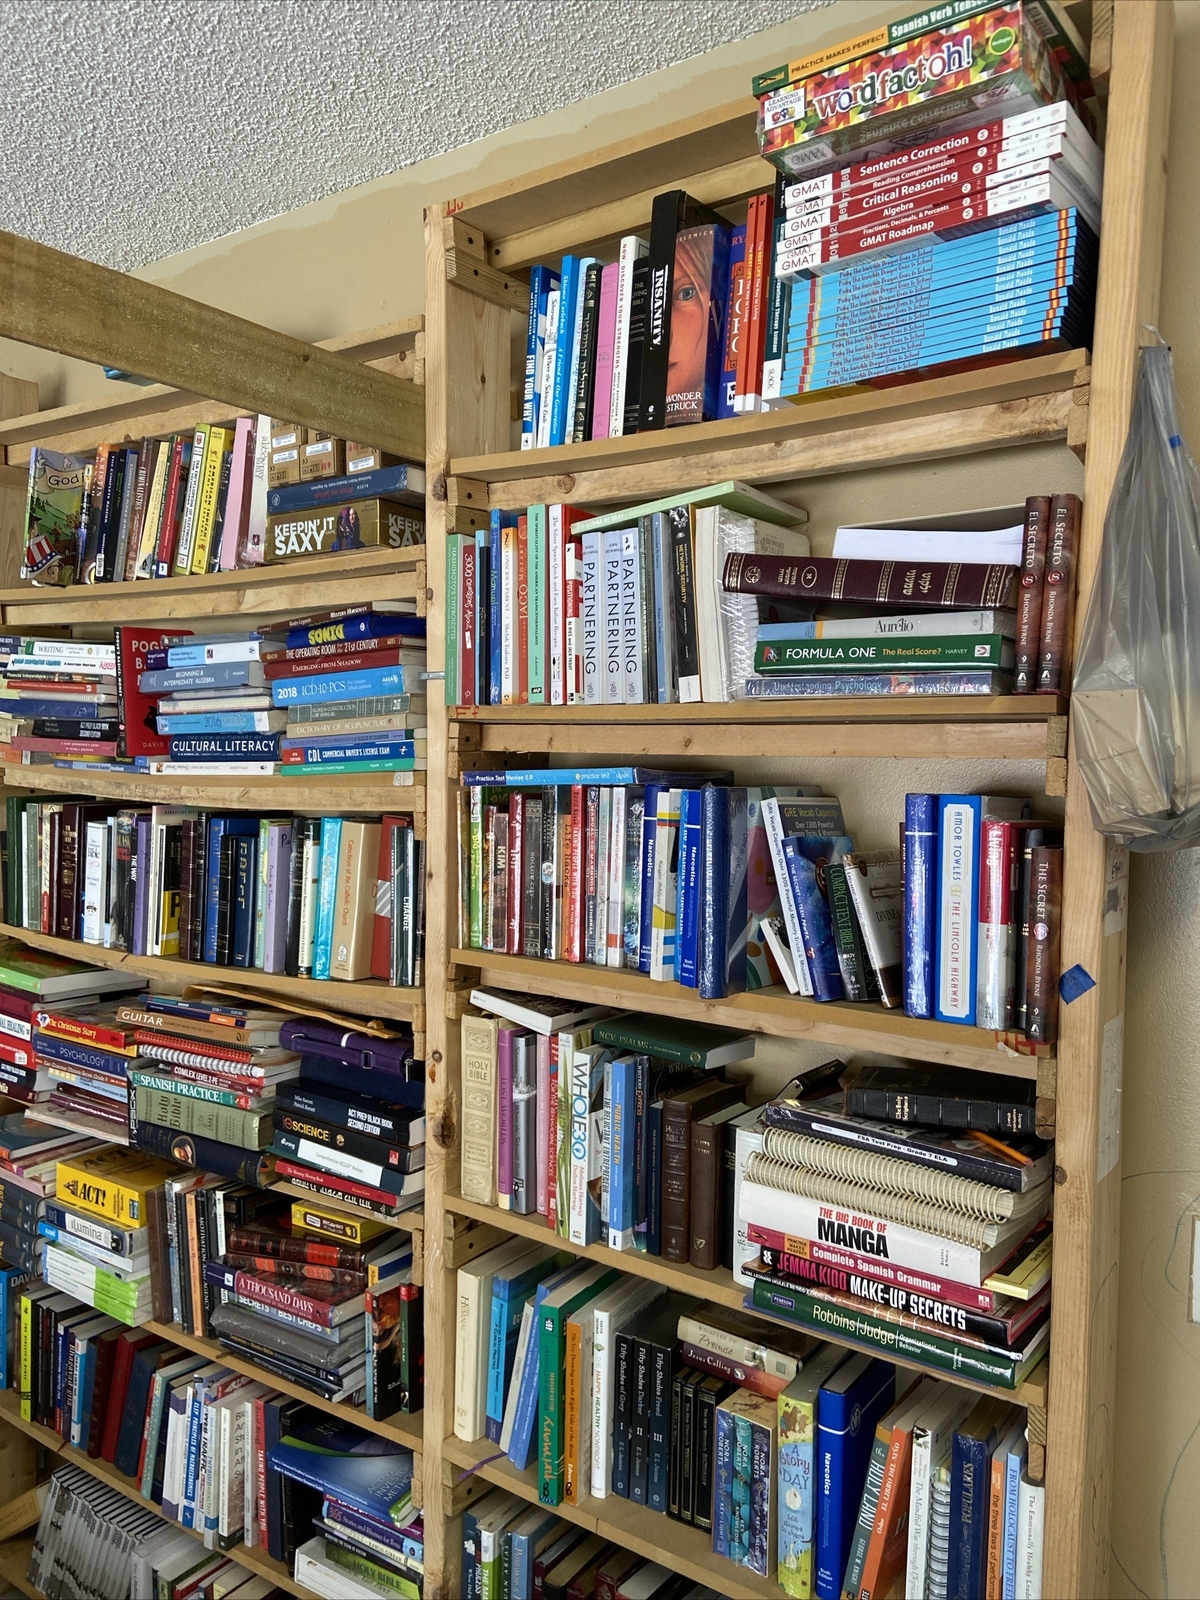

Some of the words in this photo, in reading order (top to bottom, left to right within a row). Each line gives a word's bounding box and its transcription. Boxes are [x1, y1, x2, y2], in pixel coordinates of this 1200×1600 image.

[892, 14, 928, 38] Spanish
[930, 6, 952, 21] Verb
[791, 57, 825, 74] PRACTICE
[826, 47, 851, 63] MAKES
[853, 33, 885, 49] PERFECT
[766, 98, 801, 113] ADVANTAGE
[769, 91, 798, 105] LEARNING
[860, 154, 908, 177] Sentence
[910, 135, 969, 161] Correction
[873, 174, 899, 188] Reading
[901, 157, 955, 182] Comprehension
[792, 179, 827, 197] GMAT
[862, 188, 900, 208] Critical
[902, 170, 958, 198] Reasoning
[795, 198, 826, 214] GMAT
[883, 202, 914, 217] Algebra
[791, 213, 825, 231] GMAT
[863, 222, 889, 235] Fractions,
[891, 215, 917, 229] Decimals,
[925, 205, 949, 216] Percents
[784, 233, 813, 249] GMAT
[859, 232, 887, 248] GMAT
[889, 220, 934, 244] Roadmap
[782, 254, 816, 271] GMAT
[652, 269, 665, 346] INSANITY
[526, 355, 535, 377] FIND
[525, 377, 534, 400] YOUR
[666, 392, 702, 403] WONDER
[523, 401, 533, 422] WHY
[667, 401, 697, 412] STRUCK
[49, 475, 78, 486] God
[1029, 511, 1038, 522] EL
[1057, 508, 1066, 519] EL
[275, 519, 320, 537] KEEPIN'
[323, 517, 336, 529] IT
[275, 530, 325, 555] SAXY
[1026, 524, 1038, 567] SECRETO
[1053, 522, 1066, 565] SECRETO
[607, 560, 619, 673] PARTNERING
[623, 559, 637, 673] PARTNERING
[1022, 593, 1031, 625] RHONDA
[1047, 591, 1057, 620] RHONDA
[584, 562, 596, 674] PARTNERING
[874, 619, 914, 634] Aurélio
[308, 624, 345, 645] DINOS
[1021, 626, 1029, 645] BYRNE
[1045, 621, 1053, 643] BYRNE
[786, 648, 844, 659] FORMULA
[849, 647, 876, 657] ONE
[882, 648, 894, 656] The
[278, 687, 297, 699] 2018
[302, 681, 346, 695] ICD-10-PCS
[204, 717, 221, 728] 2016
[297, 722, 330, 734] DICTIONARY
[334, 721, 341, 730] OF
[344, 718, 387, 729] ACUPUNCTURE
[173, 741, 222, 751] CULTURAL
[226, 741, 274, 751] LITERACY
[308, 749, 321, 762] CDL
[323, 749, 345, 758] COMMERCIAL
[346, 748, 362, 757] DRIVER'S
[363, 747, 378, 755] LICENSE
[954, 812, 962, 840] AMOR
[346, 840, 354, 867] Catechism
[953, 844, 961, 881] TOWLES
[1039, 862, 1048, 881] THE
[952, 902, 960, 918] THE
[1036, 883, 1047, 919] SECRET
[952, 923, 960, 960] LINCOLN
[951, 964, 959, 1009] HIGHWAY
[49, 1019, 57, 1027] The
[58, 1020, 81, 1034] Christmas
[82, 1028, 96, 1039] Story
[122, 1012, 163, 1026] GUITAR
[60, 1047, 105, 1067] PSYCHOLOGY
[469, 1060, 488, 1071] HOLY
[470, 1071, 487, 1080] BIBLE
[140, 1075, 175, 1091] SPANISH
[178, 1084, 219, 1102] PRACTICE
[357, 1111, 367, 1122] PREP
[368, 1114, 381, 1125] BLACK
[382, 1120, 393, 1129] BOOK
[573, 1063, 587, 1161] WHOLE30
[293, 1121, 329, 1141] SCIENCE
[348, 1119, 363, 1130] SECOND
[364, 1123, 380, 1135] EDITION
[871, 1138, 884, 1146] Test
[886, 1141, 900, 1150] Prep
[907, 1147, 925, 1156] Grade
[934, 1154, 948, 1162] ELA
[79, 1182, 106, 1206] ACT!
[819, 1207, 833, 1220] THE
[835, 1211, 849, 1223] BIG
[852, 1215, 874, 1228] BOOK
[877, 1222, 887, 1231] OF
[818, 1218, 889, 1259] MANGA
[813, 1247, 854, 1267] Complete
[858, 1261, 894, 1280] Spanish
[897, 1273, 941, 1292] Grammar
[239, 1278, 245, 1287] A
[247, 1281, 290, 1309] THOUSAND
[292, 1296, 314, 1313] DAYS
[773, 1296, 793, 1306] PEARSON
[777, 1254, 817, 1283] JEMMA
[819, 1266, 846, 1290] KIDD
[850, 1275, 905, 1308] MAKE-UP
[910, 1295, 966, 1330] SECRETS
[813, 1305, 855, 1331] Robbins
[860, 1325, 894, 1345] Judge
[688, 1350, 706, 1363] Jesus
[707, 1356, 731, 1374] Calling
[779, 1450, 810, 1473] Story
[783, 1469, 809, 1490] DAY
[823, 1452, 831, 1495] Narcotics
[867, 1459, 886, 1494] HOLY
[859, 1494, 878, 1531] LAND
[1007, 1494, 1016, 1554] HOLOCAUST
